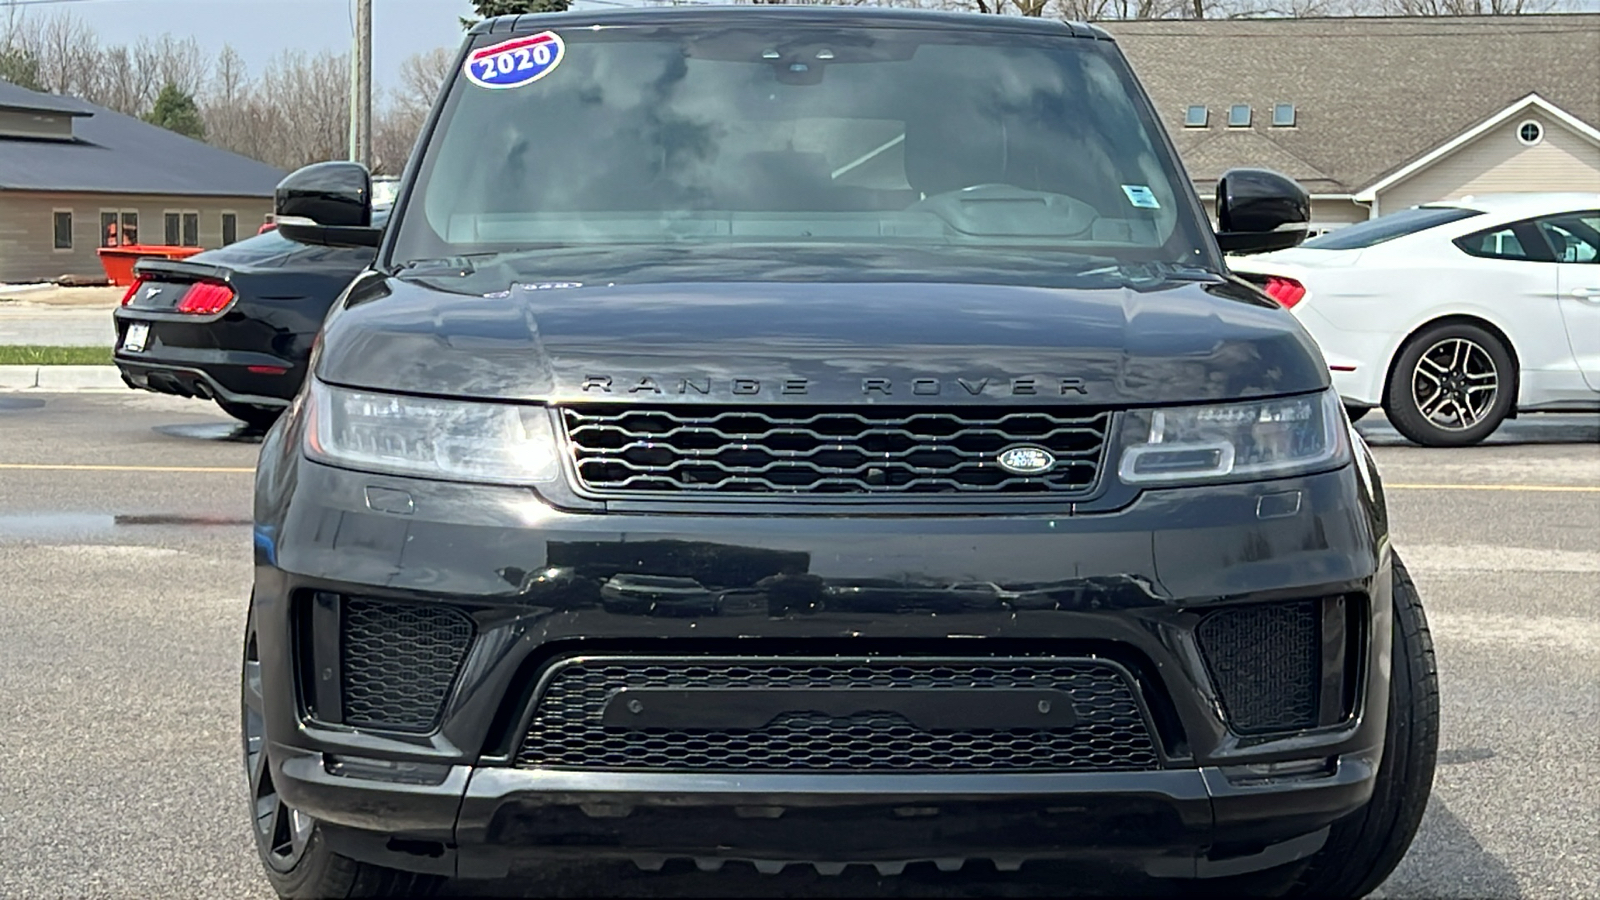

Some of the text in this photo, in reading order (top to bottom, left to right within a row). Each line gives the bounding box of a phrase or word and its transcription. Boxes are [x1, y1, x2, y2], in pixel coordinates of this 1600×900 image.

[479, 45, 551, 80] 2020
[582, 374, 1088, 396] RANGE ROVER
